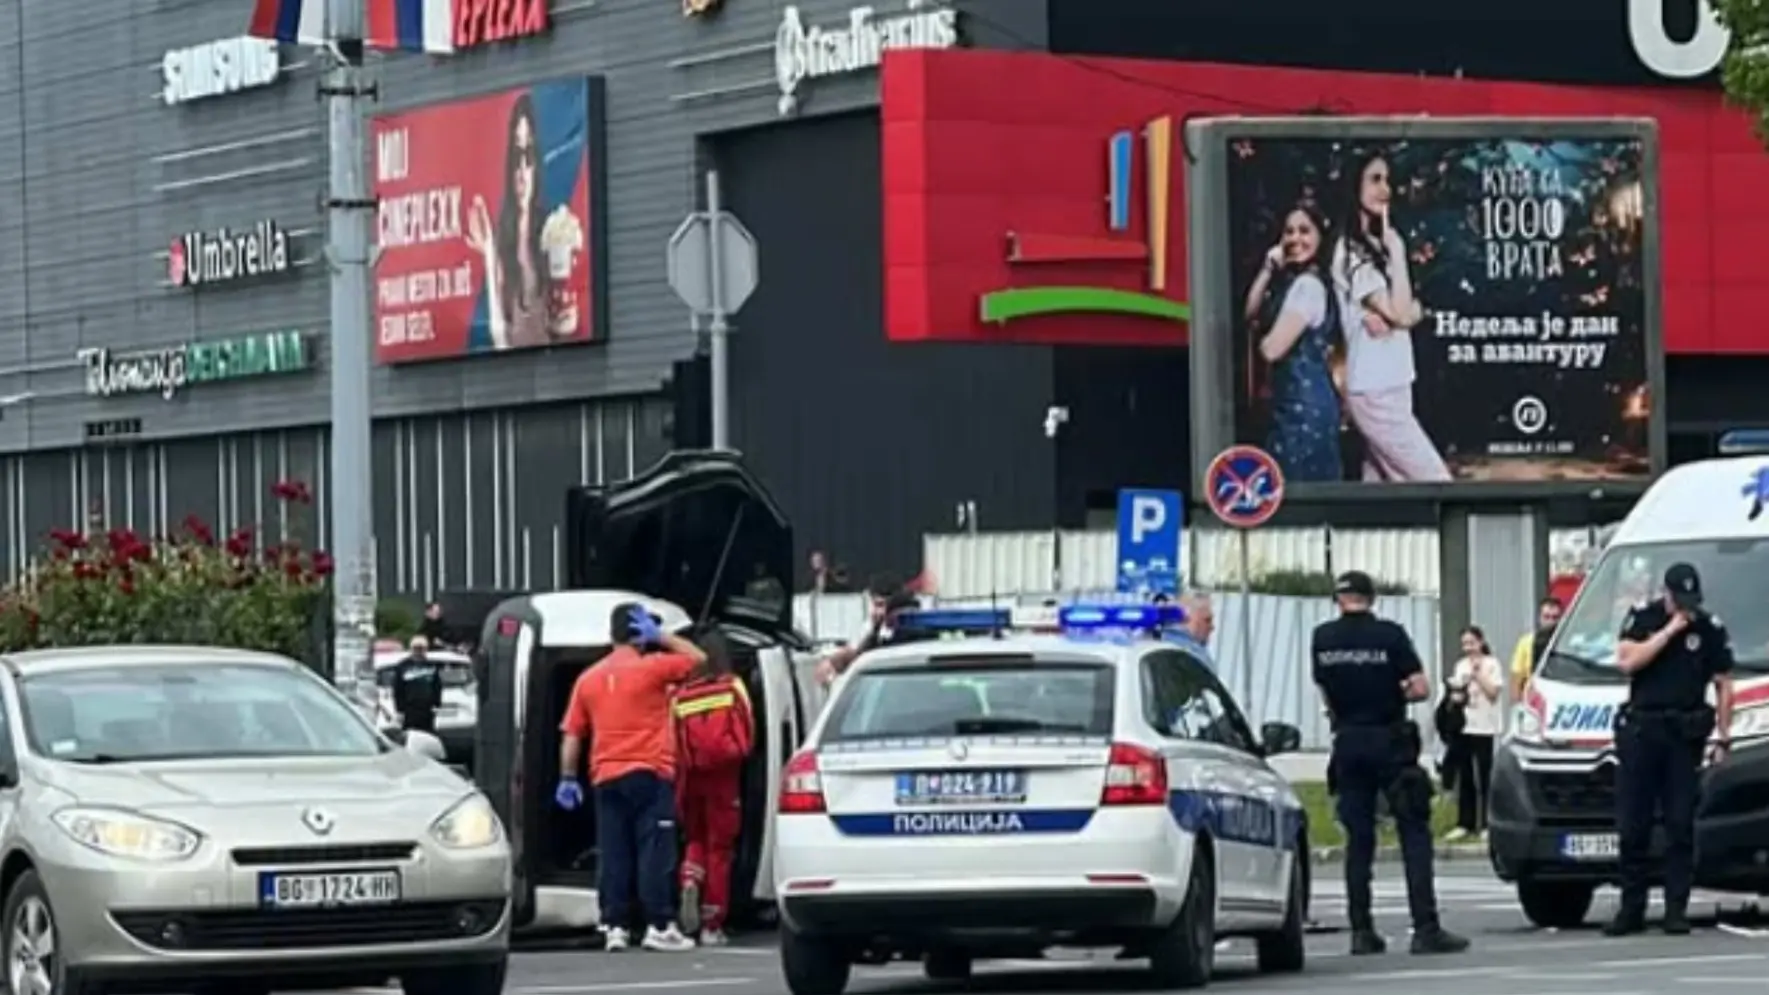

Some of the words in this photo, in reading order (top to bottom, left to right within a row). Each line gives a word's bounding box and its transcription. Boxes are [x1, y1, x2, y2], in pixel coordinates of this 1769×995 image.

[379, 185, 462, 247] CINEPLEXX
[1482, 197, 1565, 239] 1000
[185, 218, 287, 284] Umbrella
[1486, 241, 1564, 280] ВРАТА
[1435, 310, 1538, 338] Недеља
[1539, 310, 1566, 341] је
[1568, 316, 1620, 337] дан
[1447, 342, 1477, 364] за
[1481, 341, 1607, 369] авантуру
[1132, 496, 1166, 543] P
[894, 811, 1023, 833] ПОЛИЦИЈА
[278, 878, 302, 901] BG
